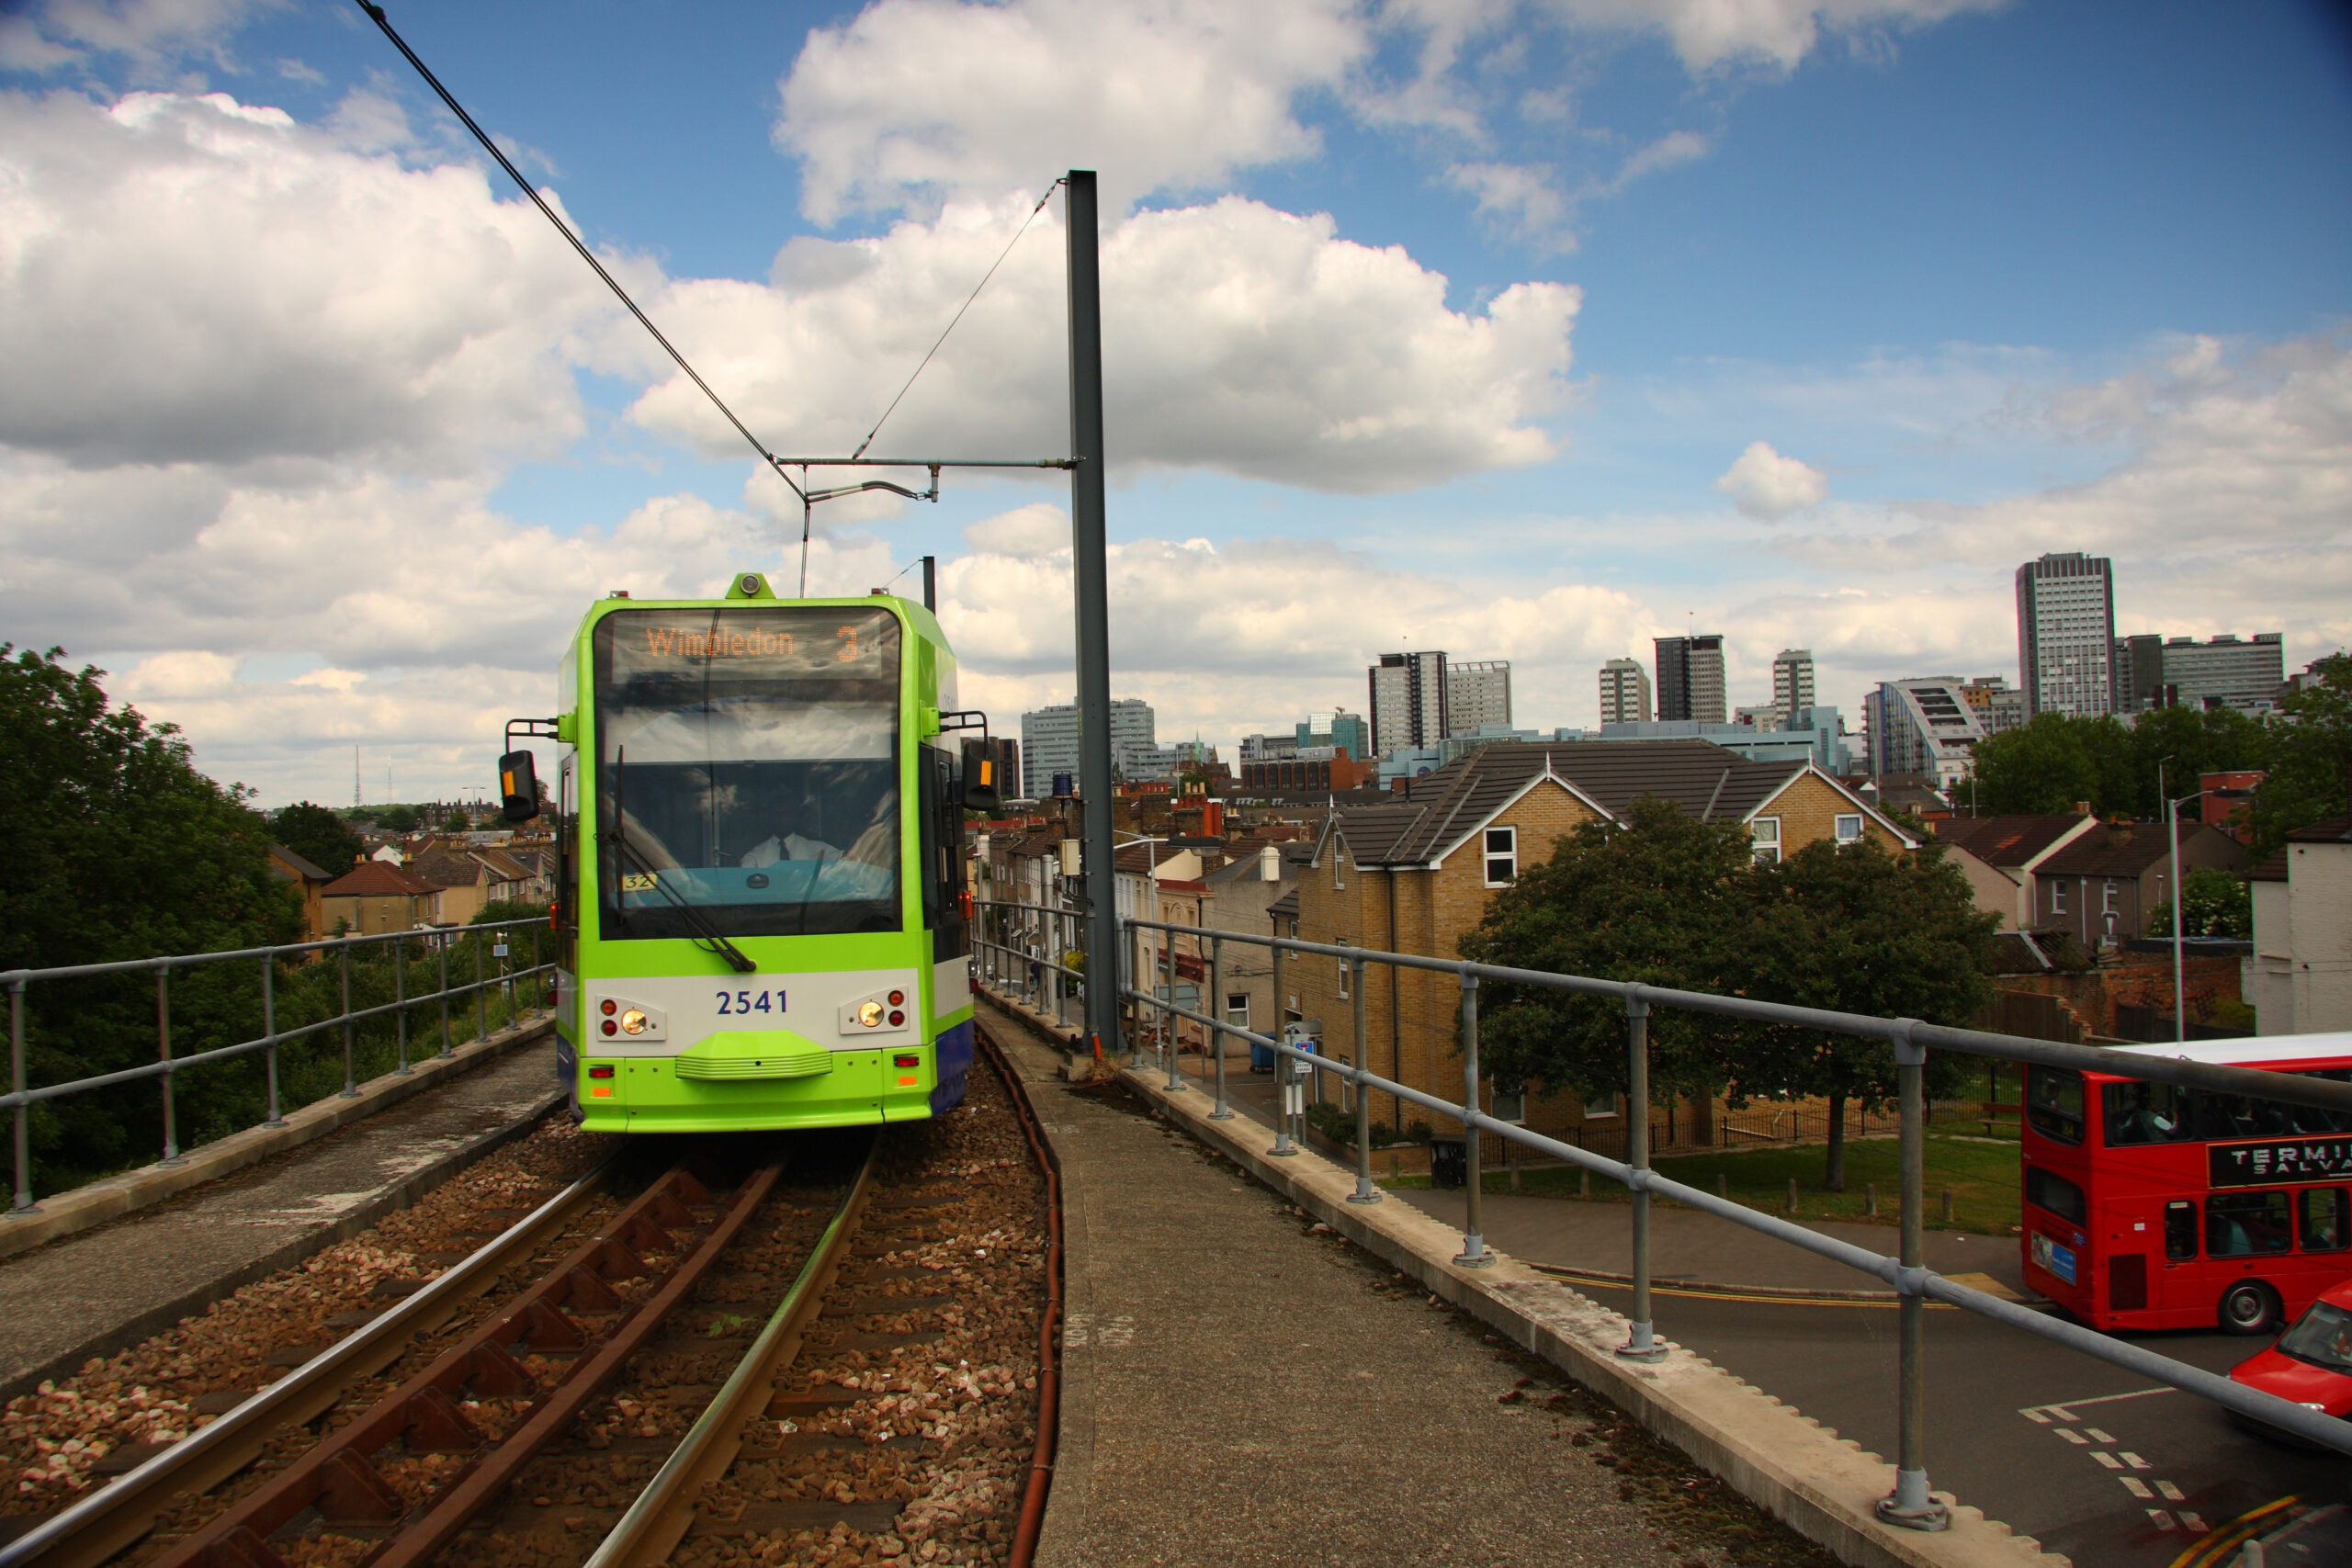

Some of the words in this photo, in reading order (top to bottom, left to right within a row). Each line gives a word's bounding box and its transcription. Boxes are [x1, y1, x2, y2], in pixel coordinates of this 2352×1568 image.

[646, 626, 794, 657] Wimbledon
[836, 626, 858, 662] 3
[716, 989, 787, 1015] 2541
[2231, 1145, 2352, 1165] TERMI
